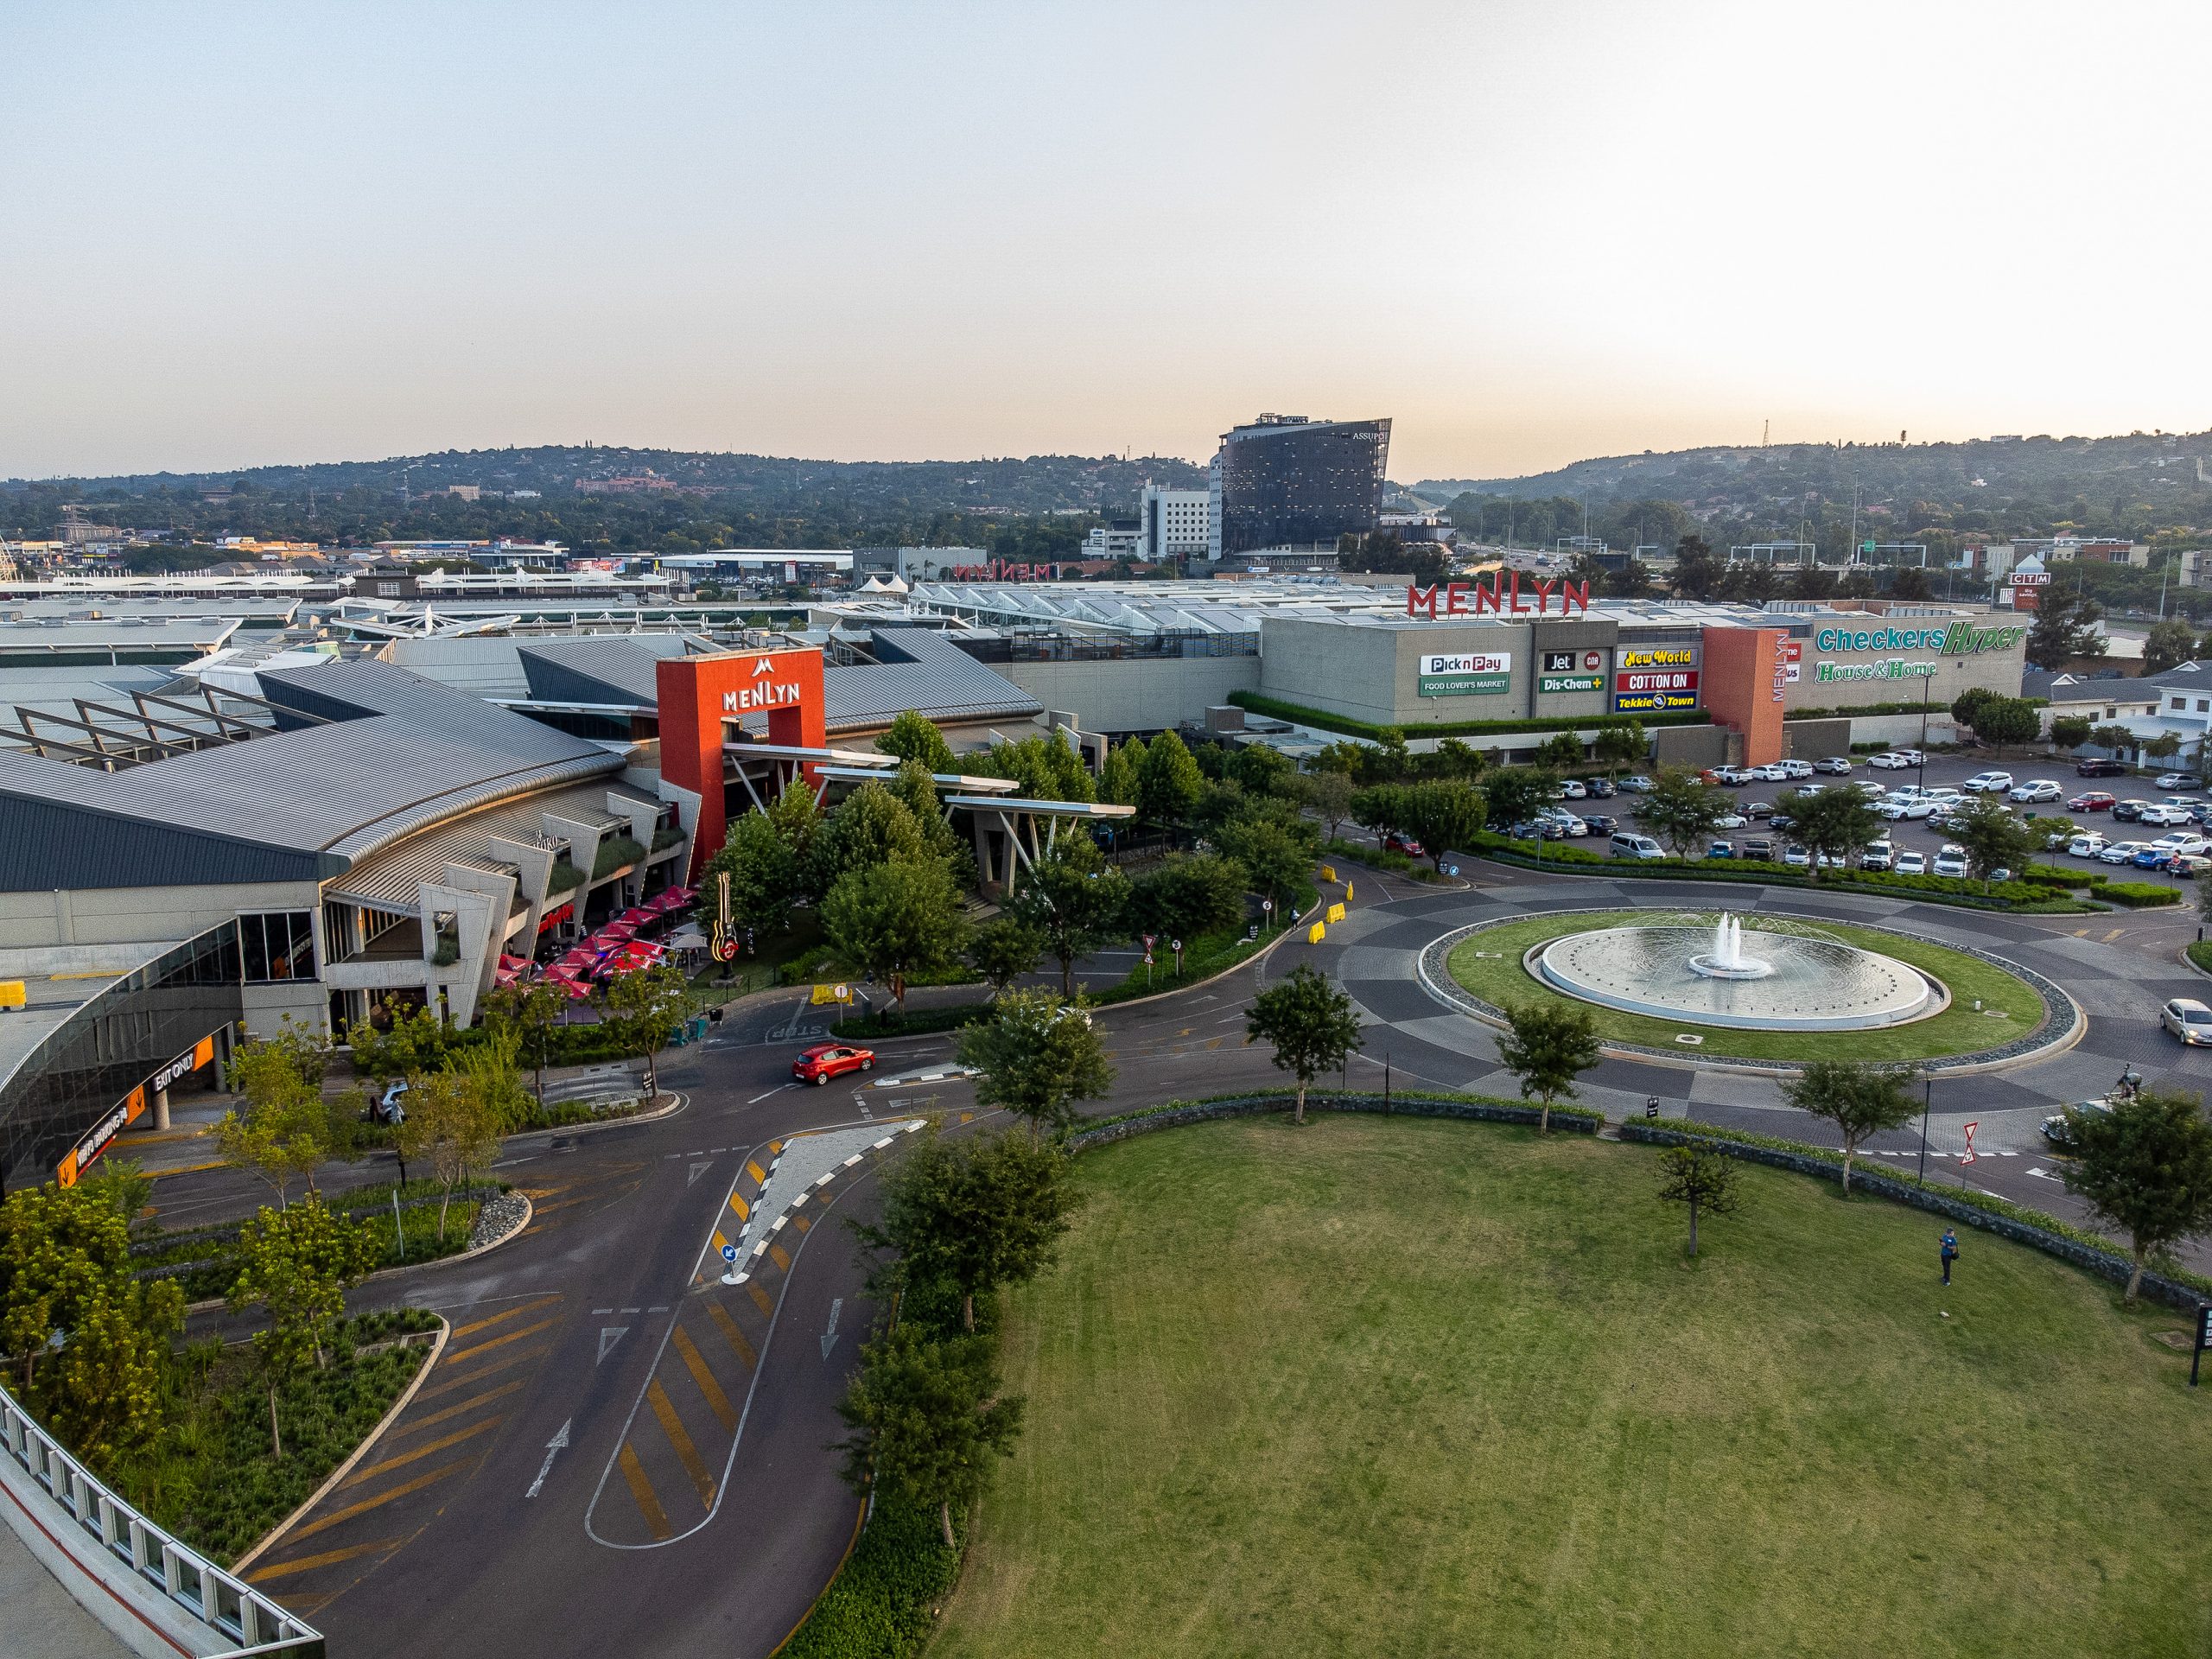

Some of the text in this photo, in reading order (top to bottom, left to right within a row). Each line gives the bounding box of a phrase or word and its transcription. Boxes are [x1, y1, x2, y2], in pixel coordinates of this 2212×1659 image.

[1407, 570, 1589, 620] MENLYN
[1817, 620, 2025, 655] Checkers Hyper
[1431, 657, 1501, 672] Pick n Pay
[1551, 655, 1571, 670] Jet
[1624, 649, 1691, 667] New World
[1772, 633, 1789, 702] MENLYN
[1817, 659, 1937, 683] House & Home
[1446, 681, 1476, 690] LOVER'S
[1477, 680, 1506, 689] MARKET
[1544, 678, 1592, 690] Dis-Chem
[1629, 674, 1688, 690] COTTON ON
[722, 681, 800, 712] MENLYN
[1618, 696, 1694, 709] Tekkie Town
[155, 1053, 194, 1091] EXIT ONLY
